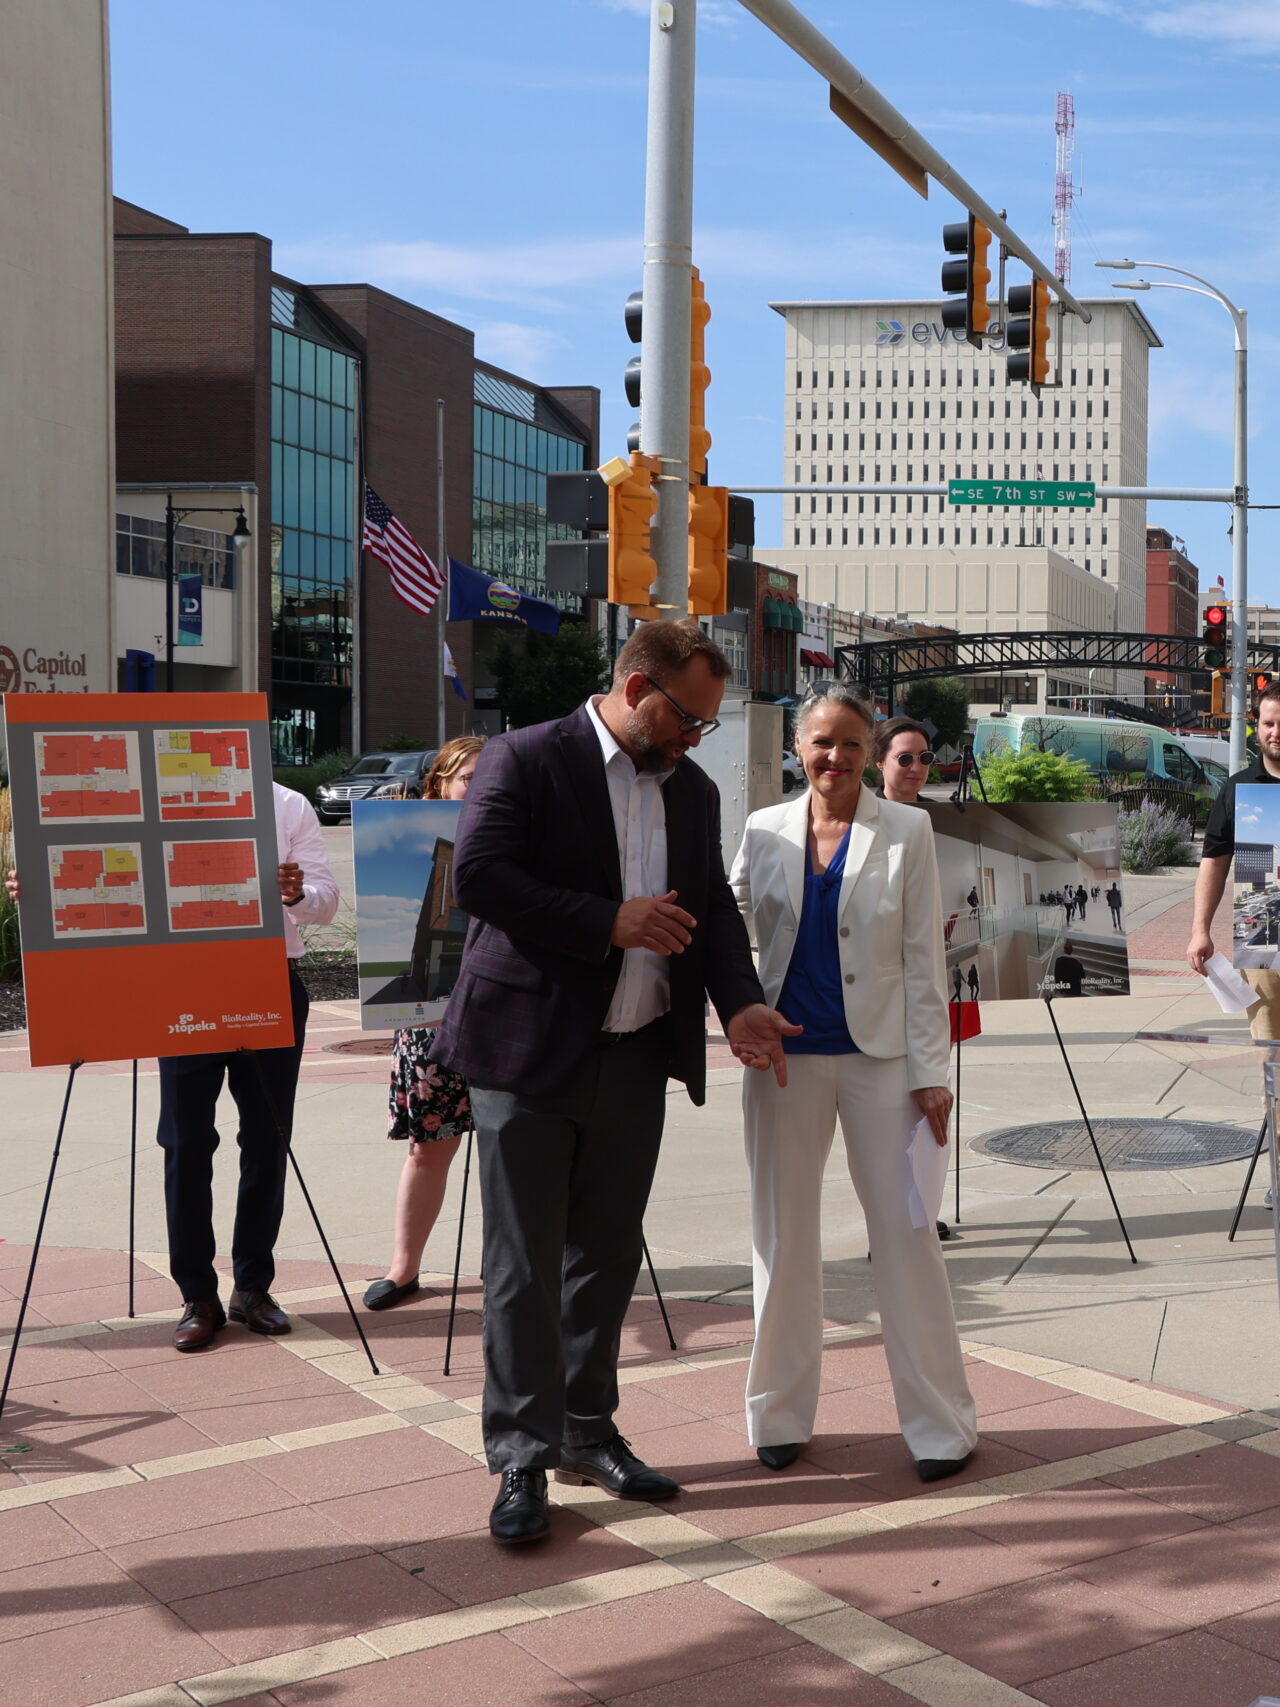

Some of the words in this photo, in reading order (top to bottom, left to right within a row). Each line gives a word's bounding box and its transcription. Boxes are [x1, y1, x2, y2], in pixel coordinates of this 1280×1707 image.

[967, 488, 984, 500] SE
[992, 486, 1021, 500] 7th
[1029, 490, 1046, 500] ST
[1057, 491, 1076, 501] SW
[23, 647, 87, 680] Capitol
[1044, 975, 1055, 984] go
[1041, 981, 1071, 991] topeka
[179, 1013, 194, 1024] go
[221, 1012, 266, 1023] BioReality,
[267, 1011, 282, 1020] Inc.
[174, 1020, 217, 1034] topeka
